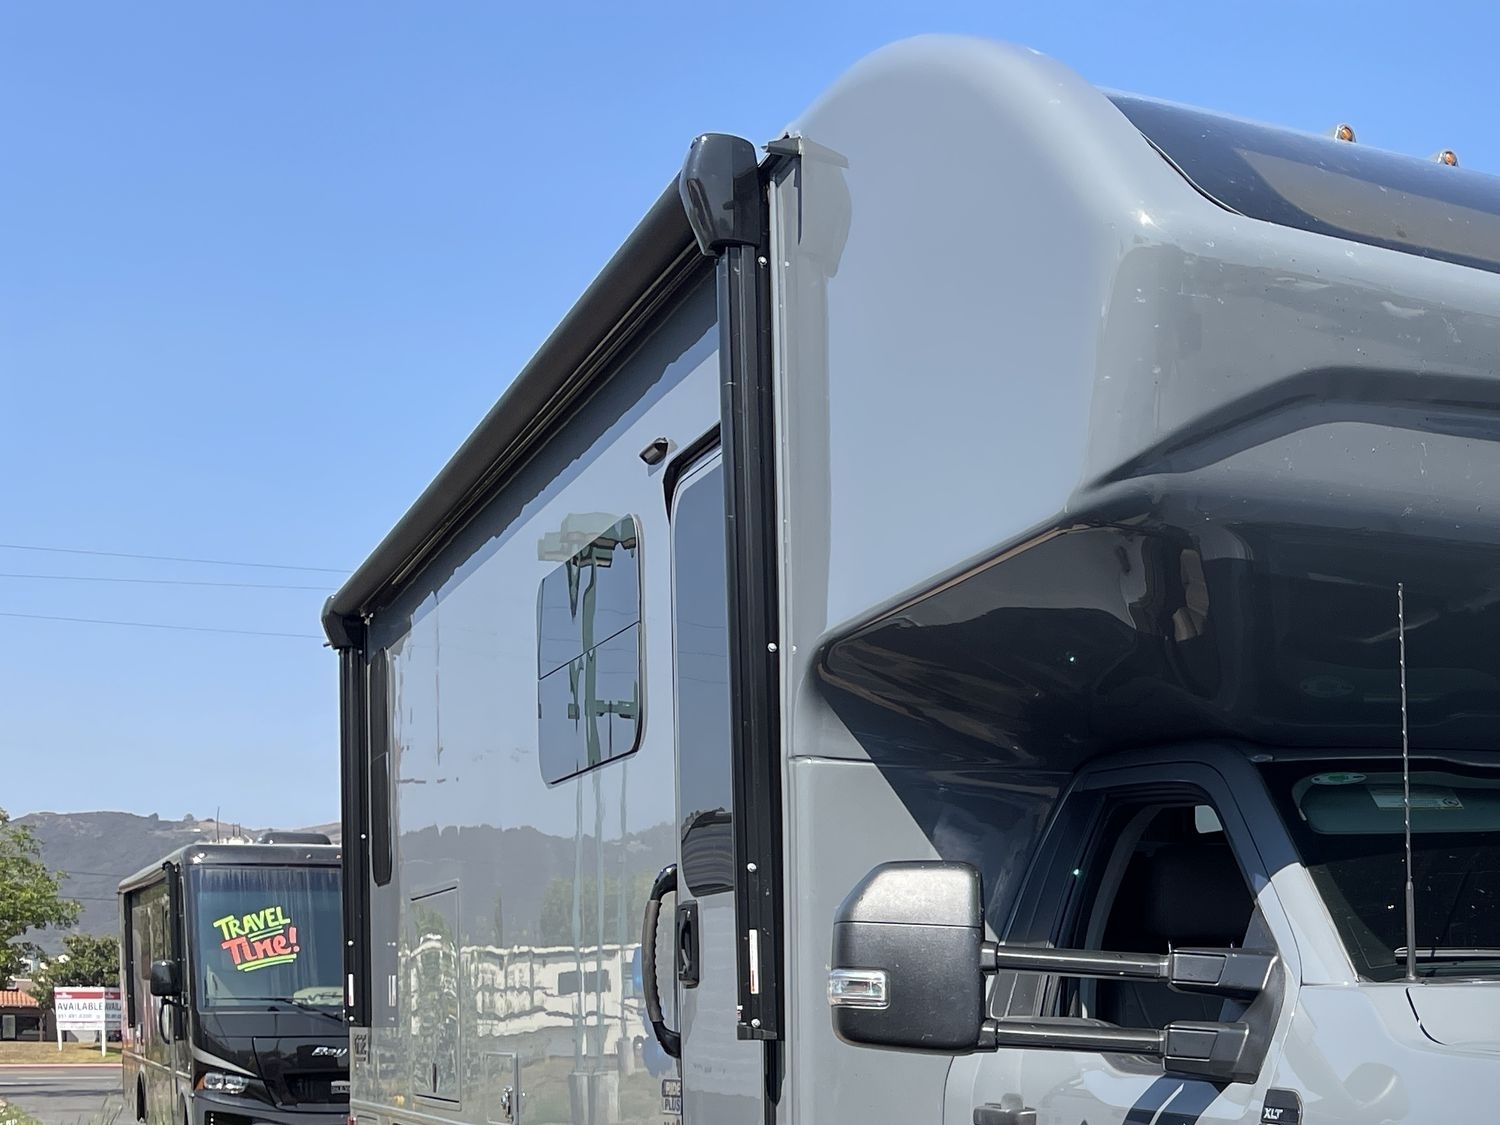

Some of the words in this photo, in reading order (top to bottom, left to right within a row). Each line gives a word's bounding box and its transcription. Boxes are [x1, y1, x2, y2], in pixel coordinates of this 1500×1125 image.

[213, 906, 291, 940] TRAVEL
[57, 1002, 103, 1011] AVAILABLE
[1263, 1107, 1284, 1119] XLT
